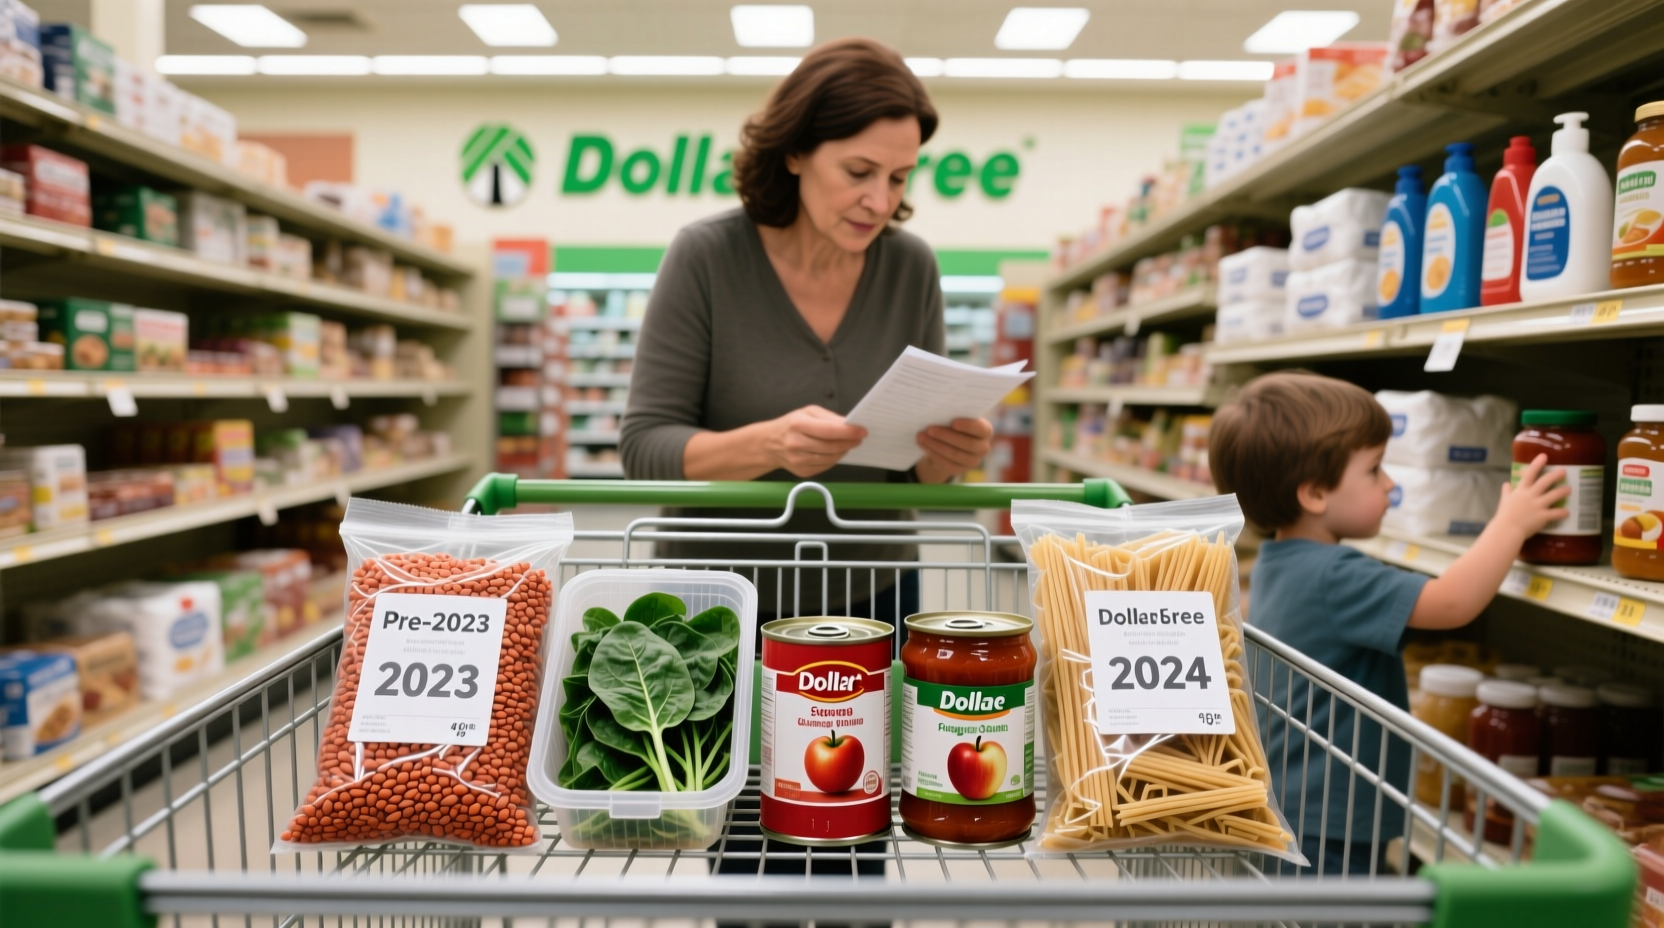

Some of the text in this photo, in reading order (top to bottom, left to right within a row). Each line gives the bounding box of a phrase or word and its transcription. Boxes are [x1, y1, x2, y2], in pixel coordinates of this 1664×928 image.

[562, 135, 1019, 198] Dolla ree
[382, 610, 490, 633] Pre-2023
[374, 661, 479, 699] 2023
[1108, 655, 1212, 690] 2024
